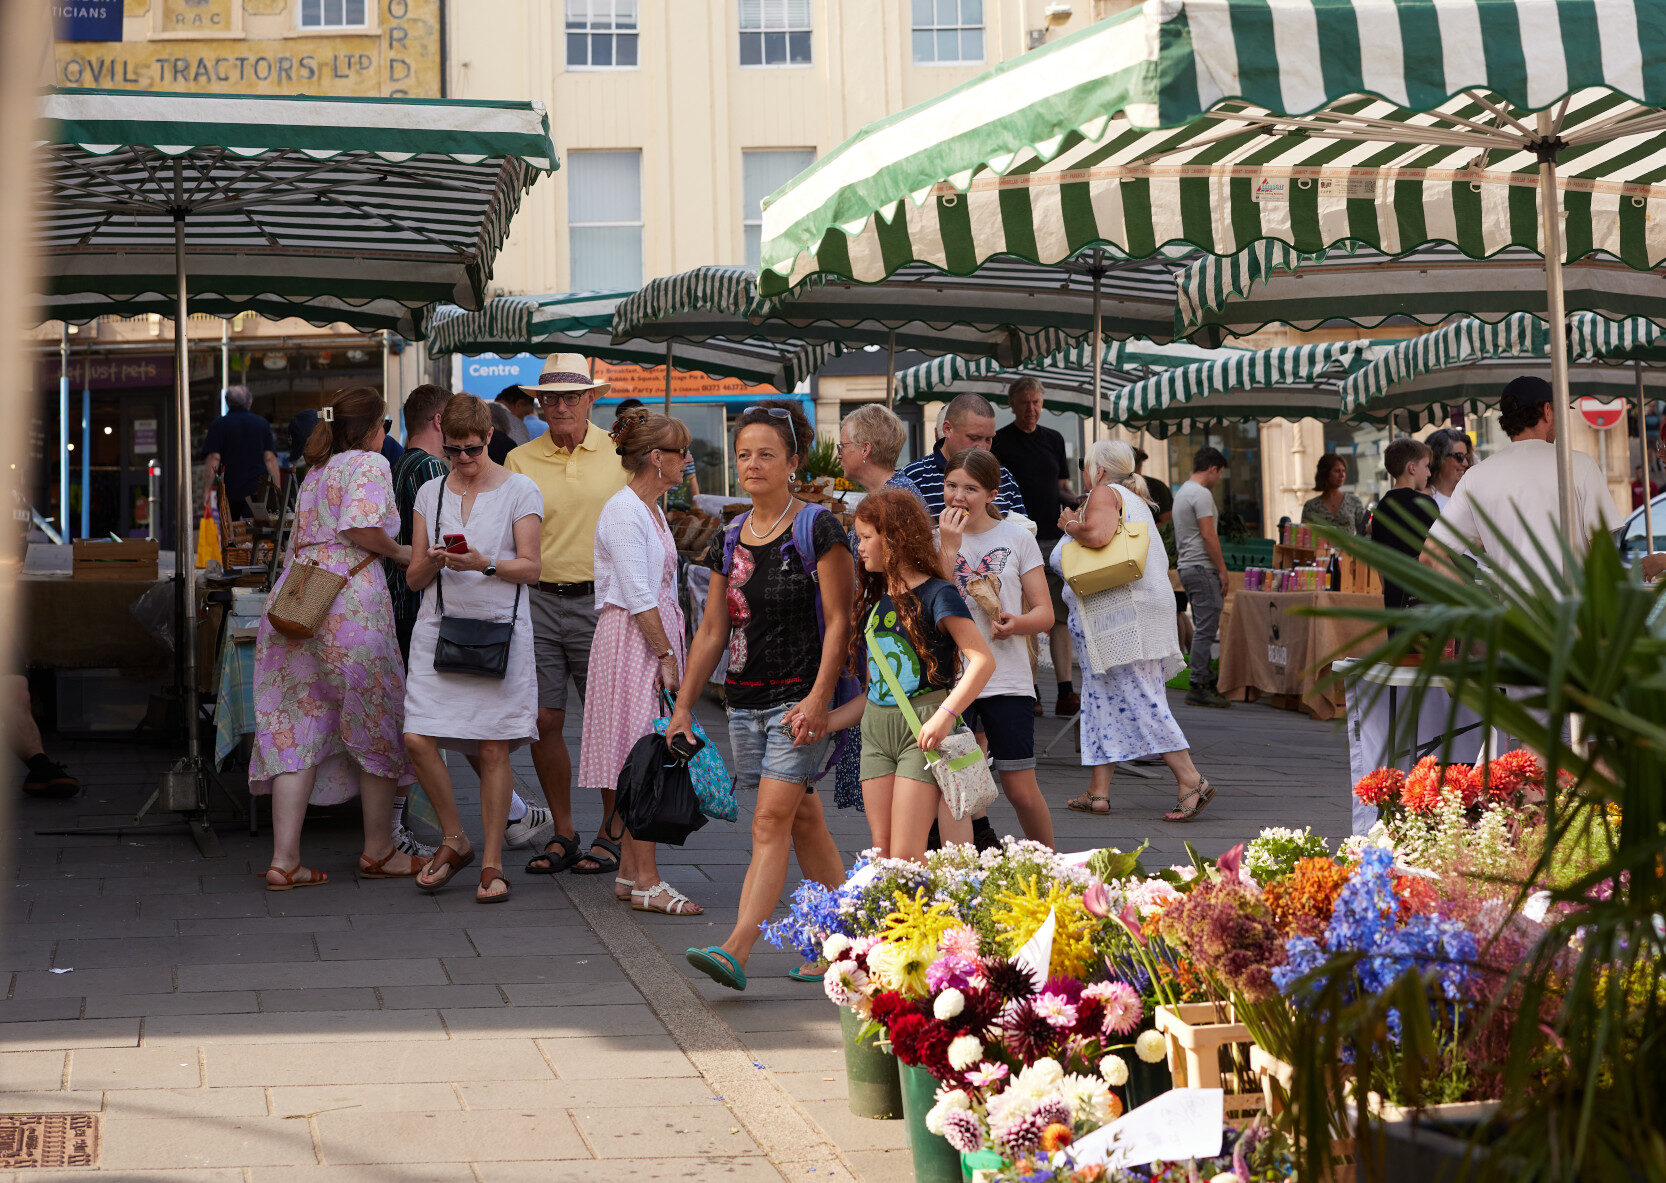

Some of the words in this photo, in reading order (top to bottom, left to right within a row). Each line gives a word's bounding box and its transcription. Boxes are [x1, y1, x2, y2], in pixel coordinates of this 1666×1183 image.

[63, 58, 139, 84] OVIL
[154, 54, 316, 83] TRACTORS
[333, 52, 372, 78] LTD
[86, 362, 119, 382] ust
[121, 361, 157, 382] pets
[469, 364, 520, 377] Centre
